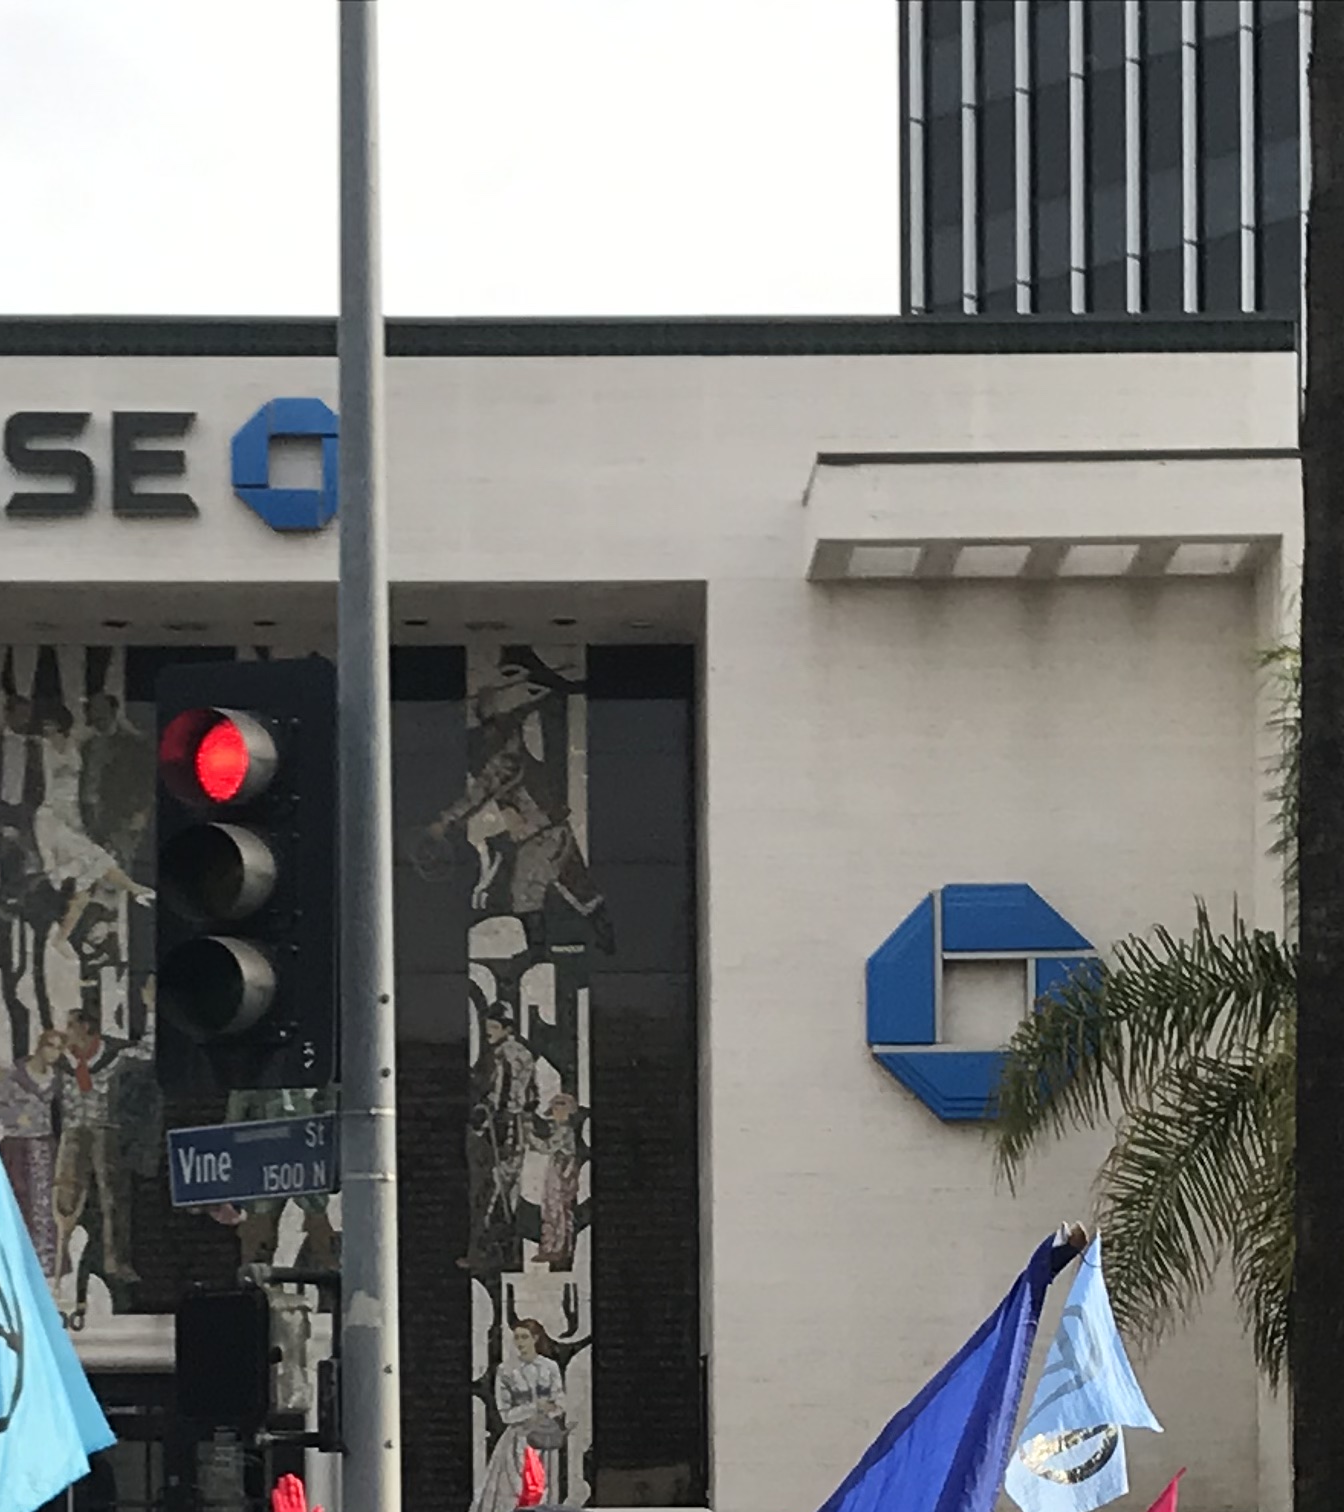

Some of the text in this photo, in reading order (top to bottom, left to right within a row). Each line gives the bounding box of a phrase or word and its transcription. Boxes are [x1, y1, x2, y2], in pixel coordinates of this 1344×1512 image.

[306, 1121, 325, 1148] St
[178, 1147, 233, 1185] Vine
[263, 1160, 326, 1191] 1500 N
